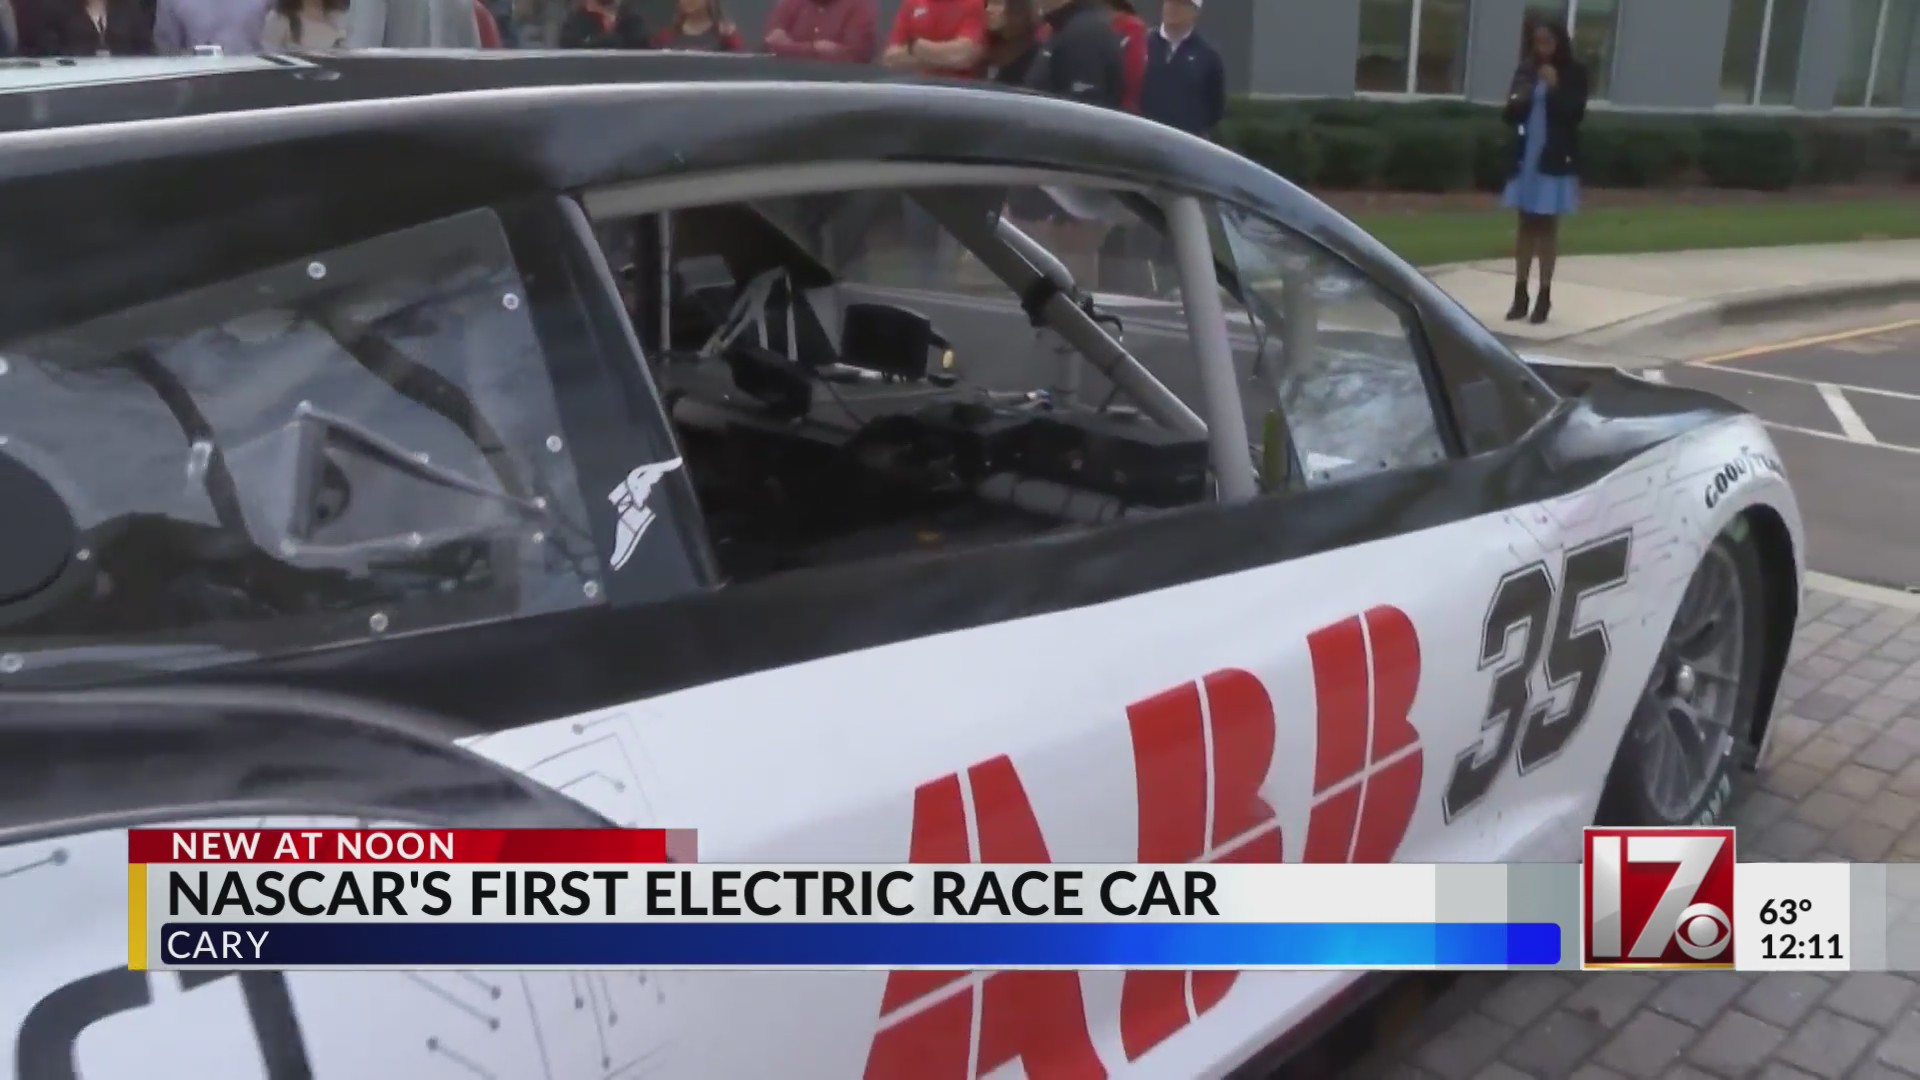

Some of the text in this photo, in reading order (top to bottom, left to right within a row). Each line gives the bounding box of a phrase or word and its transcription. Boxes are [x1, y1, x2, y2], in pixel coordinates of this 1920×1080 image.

[1704, 446, 1786, 509] GOOD
[1442, 526, 1632, 825] 35
[862, 603, 1424, 1080] ABB
